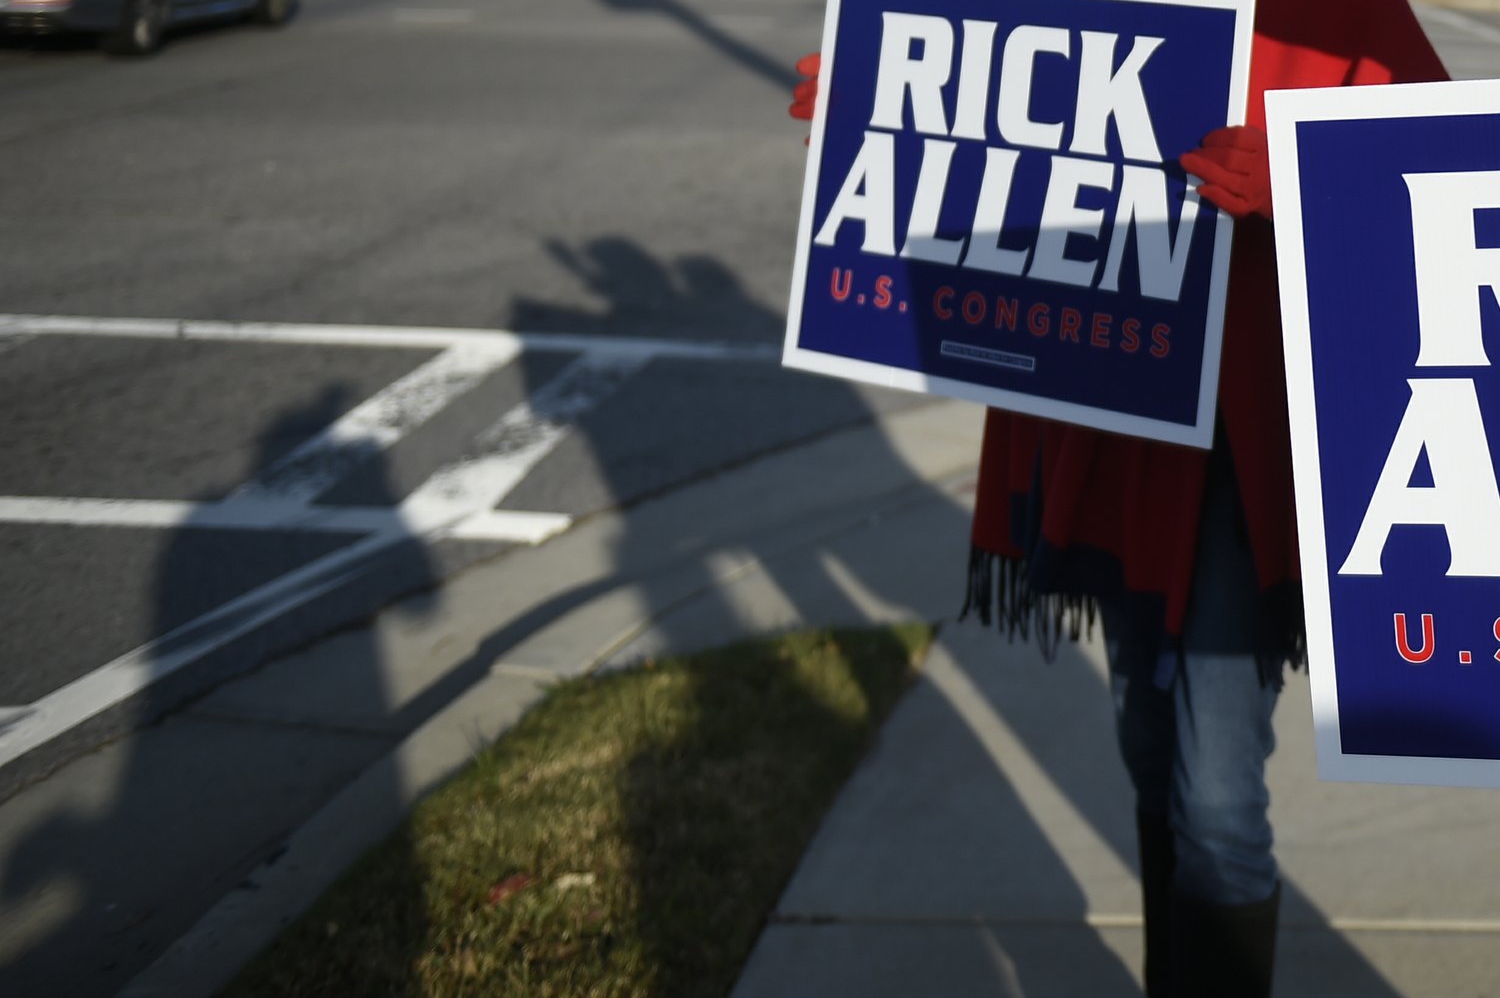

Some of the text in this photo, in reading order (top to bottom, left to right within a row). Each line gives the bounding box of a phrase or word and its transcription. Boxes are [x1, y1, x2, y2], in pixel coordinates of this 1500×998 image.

[868, 11, 1166, 163] RICK
[813, 130, 1203, 302] ALLEN
[829, 267, 908, 313] U.S.
[932, 285, 1171, 358] CONGRESS
